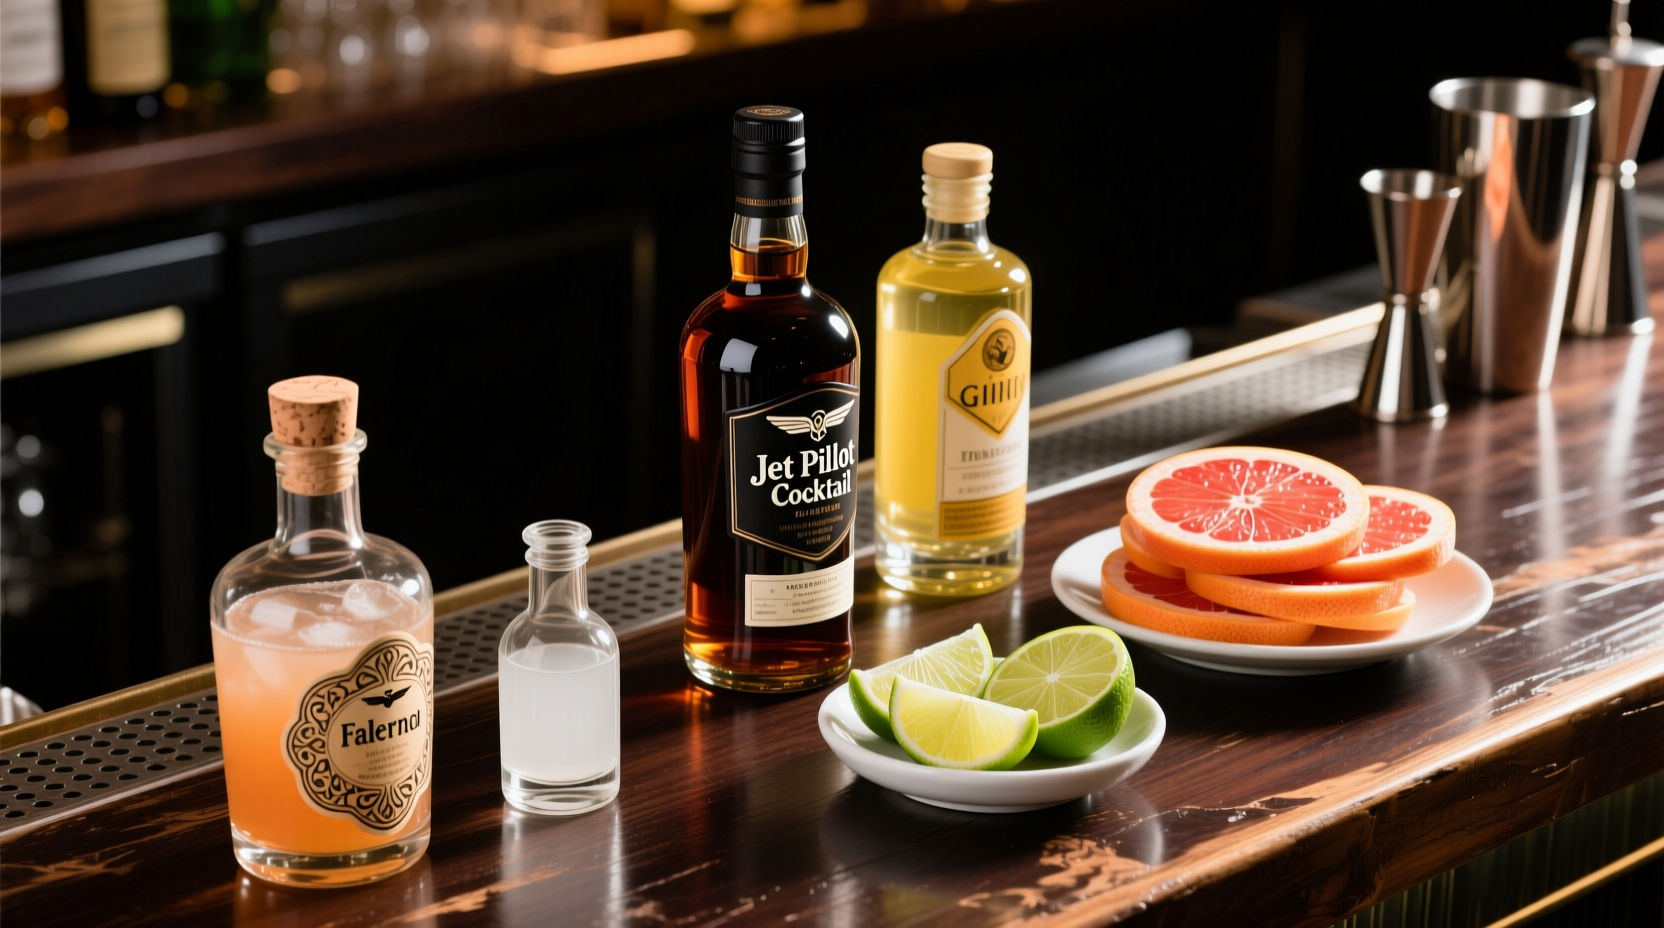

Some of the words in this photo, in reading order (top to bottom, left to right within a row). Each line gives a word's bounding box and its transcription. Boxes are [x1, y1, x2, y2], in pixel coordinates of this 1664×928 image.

[750, 454, 794, 486] Jet
[799, 439, 855, 477] Pillot
[771, 469, 852, 507] Cocktail
